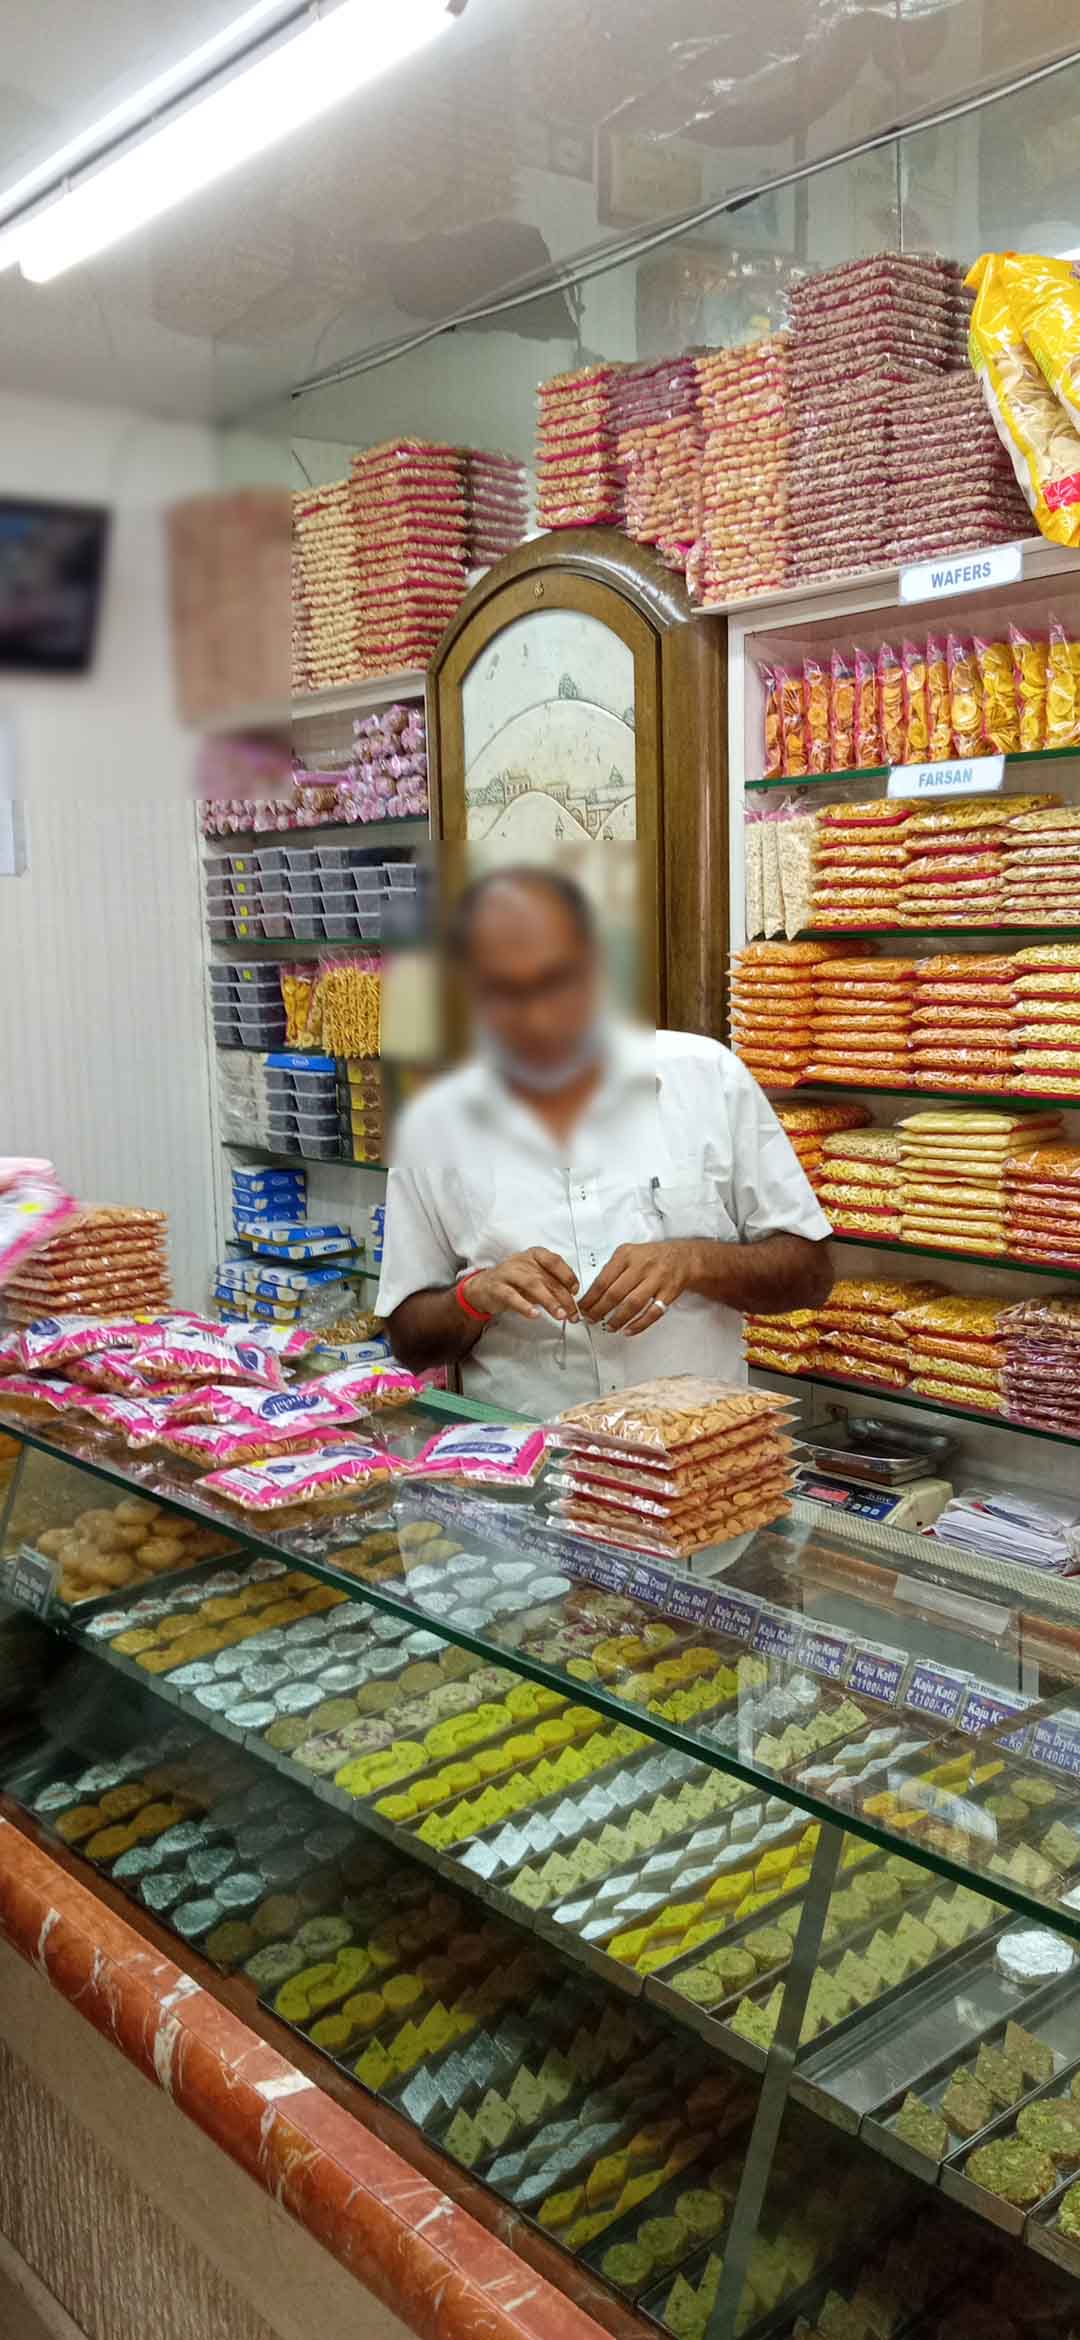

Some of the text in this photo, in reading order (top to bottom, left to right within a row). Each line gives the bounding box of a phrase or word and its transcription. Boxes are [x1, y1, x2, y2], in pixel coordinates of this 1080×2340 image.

[930, 561, 992, 589] WAFERS
[918, 767, 974, 788] FARSAN
[855, 1660, 876, 1678] Kaju
[882, 1686, 897, 1703] Kg
[913, 1678, 935, 1695] Kaju
[940, 1703, 955, 1719] Kg
[967, 1701, 990, 1721] Kaju
